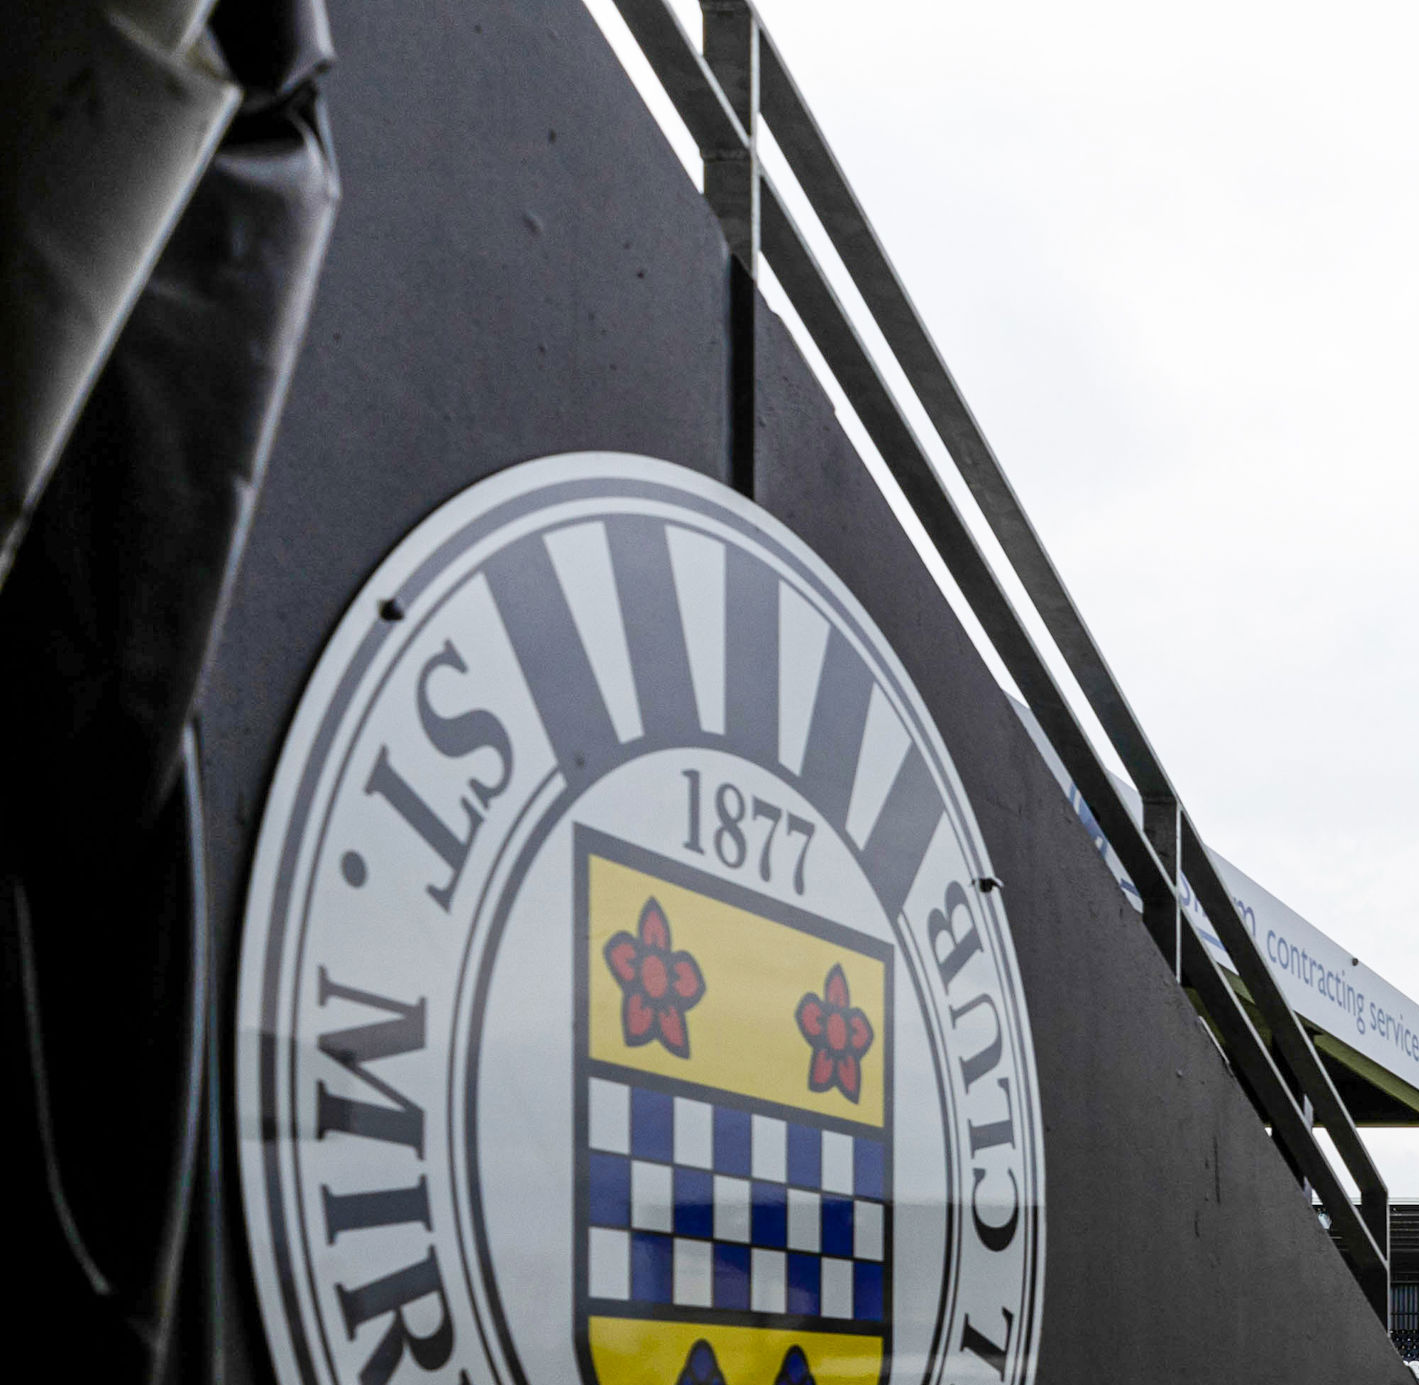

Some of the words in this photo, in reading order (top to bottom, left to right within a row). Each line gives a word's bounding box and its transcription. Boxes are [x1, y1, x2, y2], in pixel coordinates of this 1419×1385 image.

[681, 768, 816, 897] 1877
[1267, 929, 1366, 1035] contracting
[926, 878, 1022, 1253] CLUB
